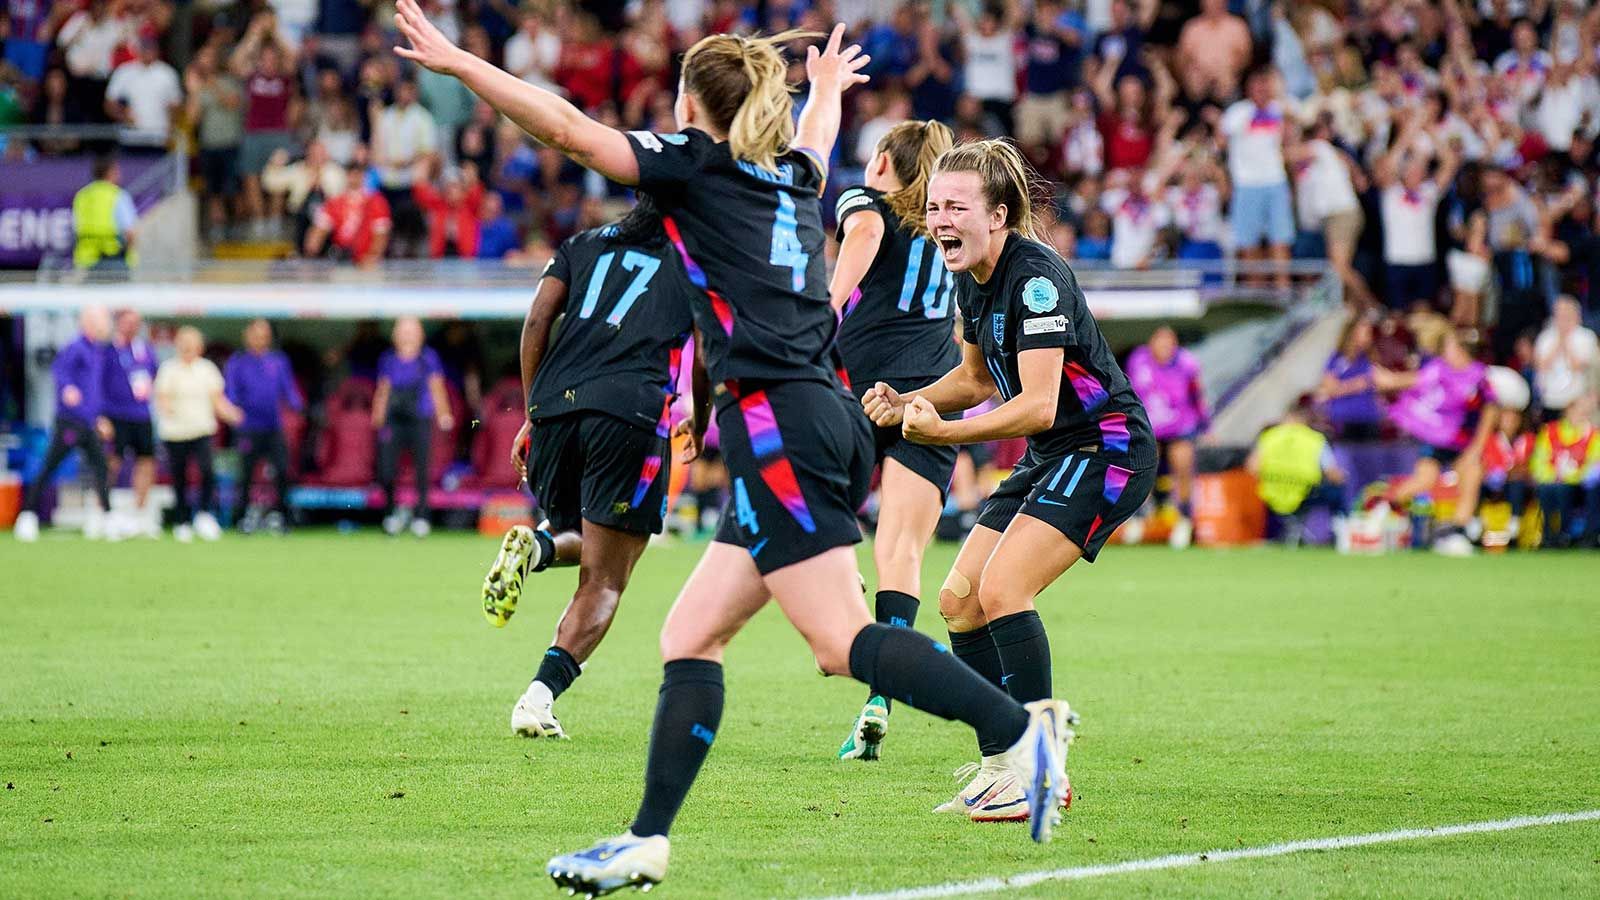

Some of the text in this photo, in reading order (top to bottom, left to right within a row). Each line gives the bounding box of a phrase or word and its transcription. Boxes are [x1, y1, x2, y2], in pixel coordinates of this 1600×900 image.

[769, 189, 809, 292] 4
[897, 235, 955, 319] 10
[579, 250, 661, 326] 17
[734, 475, 760, 535] 4
[1046, 454, 1090, 498] 11
